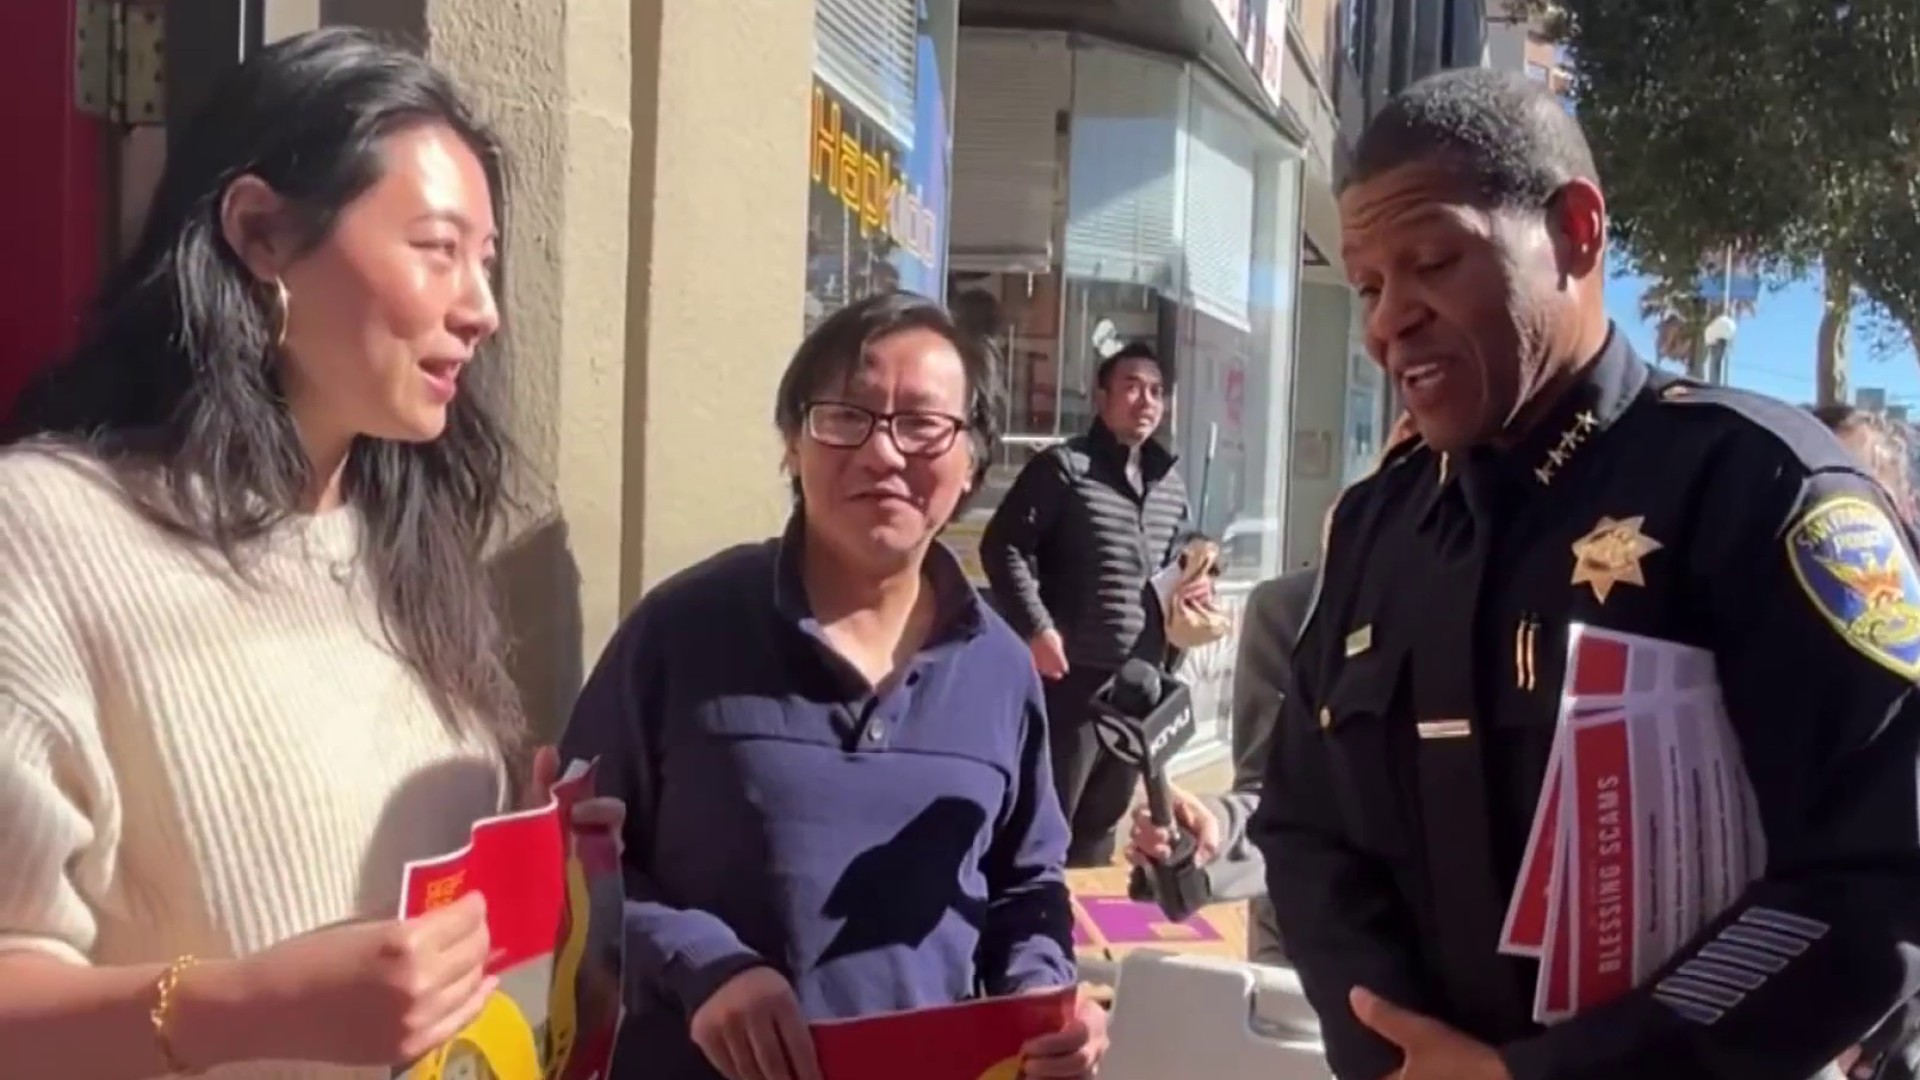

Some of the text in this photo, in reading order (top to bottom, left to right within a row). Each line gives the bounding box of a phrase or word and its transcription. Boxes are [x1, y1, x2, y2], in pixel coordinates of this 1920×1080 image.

[812, 86, 935, 268] Hapkido
[1597, 774, 1622, 974] BLESSING SCAMS
